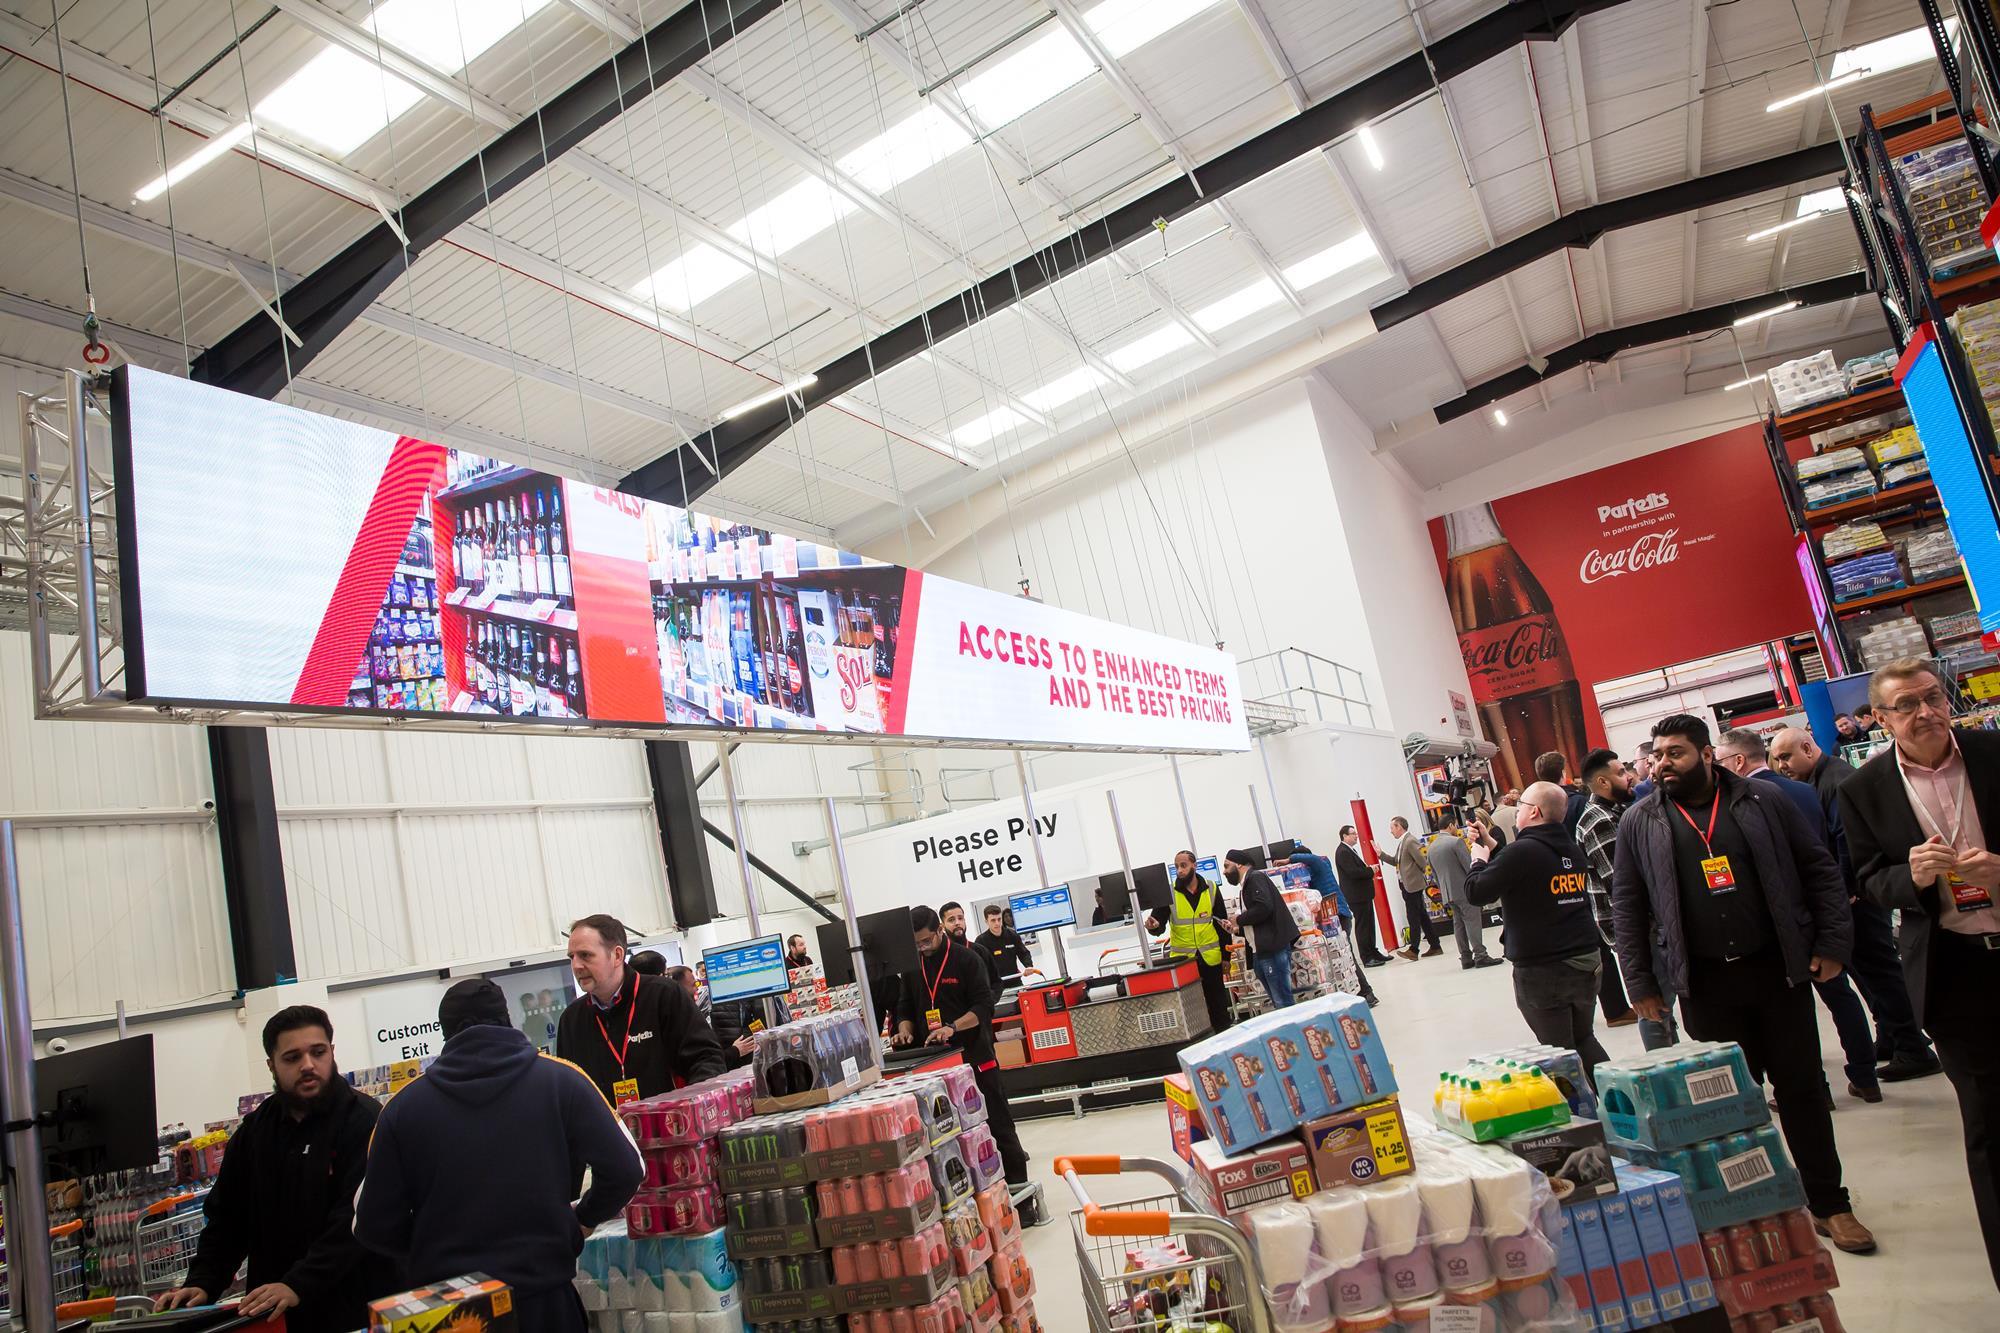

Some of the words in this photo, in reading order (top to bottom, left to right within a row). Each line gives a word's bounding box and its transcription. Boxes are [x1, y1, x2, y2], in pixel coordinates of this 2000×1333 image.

[1597, 492, 1670, 523] Parfetts
[1602, 529, 1611, 537] in
[1612, 518, 1656, 536] partnership
[1658, 512, 1675, 522] with
[1845, 582, 1865, 593] Tilda
[1872, 576, 1891, 586] Tilda
[959, 621, 1052, 670] ACCESS
[1058, 641, 1087, 675] TO
[1093, 649, 1182, 691] ENHANCED
[1185, 668, 1227, 698] TERMS
[1050, 675, 1091, 709] AND
[1096, 682, 1134, 714] THE
[1136, 688, 1175, 719] BEST
[1180, 695, 1232, 724] PRICING
[912, 828, 999, 863] Please
[958, 853, 1023, 883] Here
[1550, 873, 1586, 894] CREW
[378, 1021, 441, 1043] Custome
[402, 1043, 430, 1060] Exit
[1376, 1142, 1404, 1158] £1.25
[1355, 1160, 1369, 1168] NO
[1355, 1167, 1372, 1177] VAT
[1297, 1178, 1309, 1195] £1
[1448, 1258, 1467, 1271] GO
[1506, 1251, 1526, 1262] GO
[1395, 1270, 1414, 1280] GO
[1342, 1284, 1360, 1295] GO
